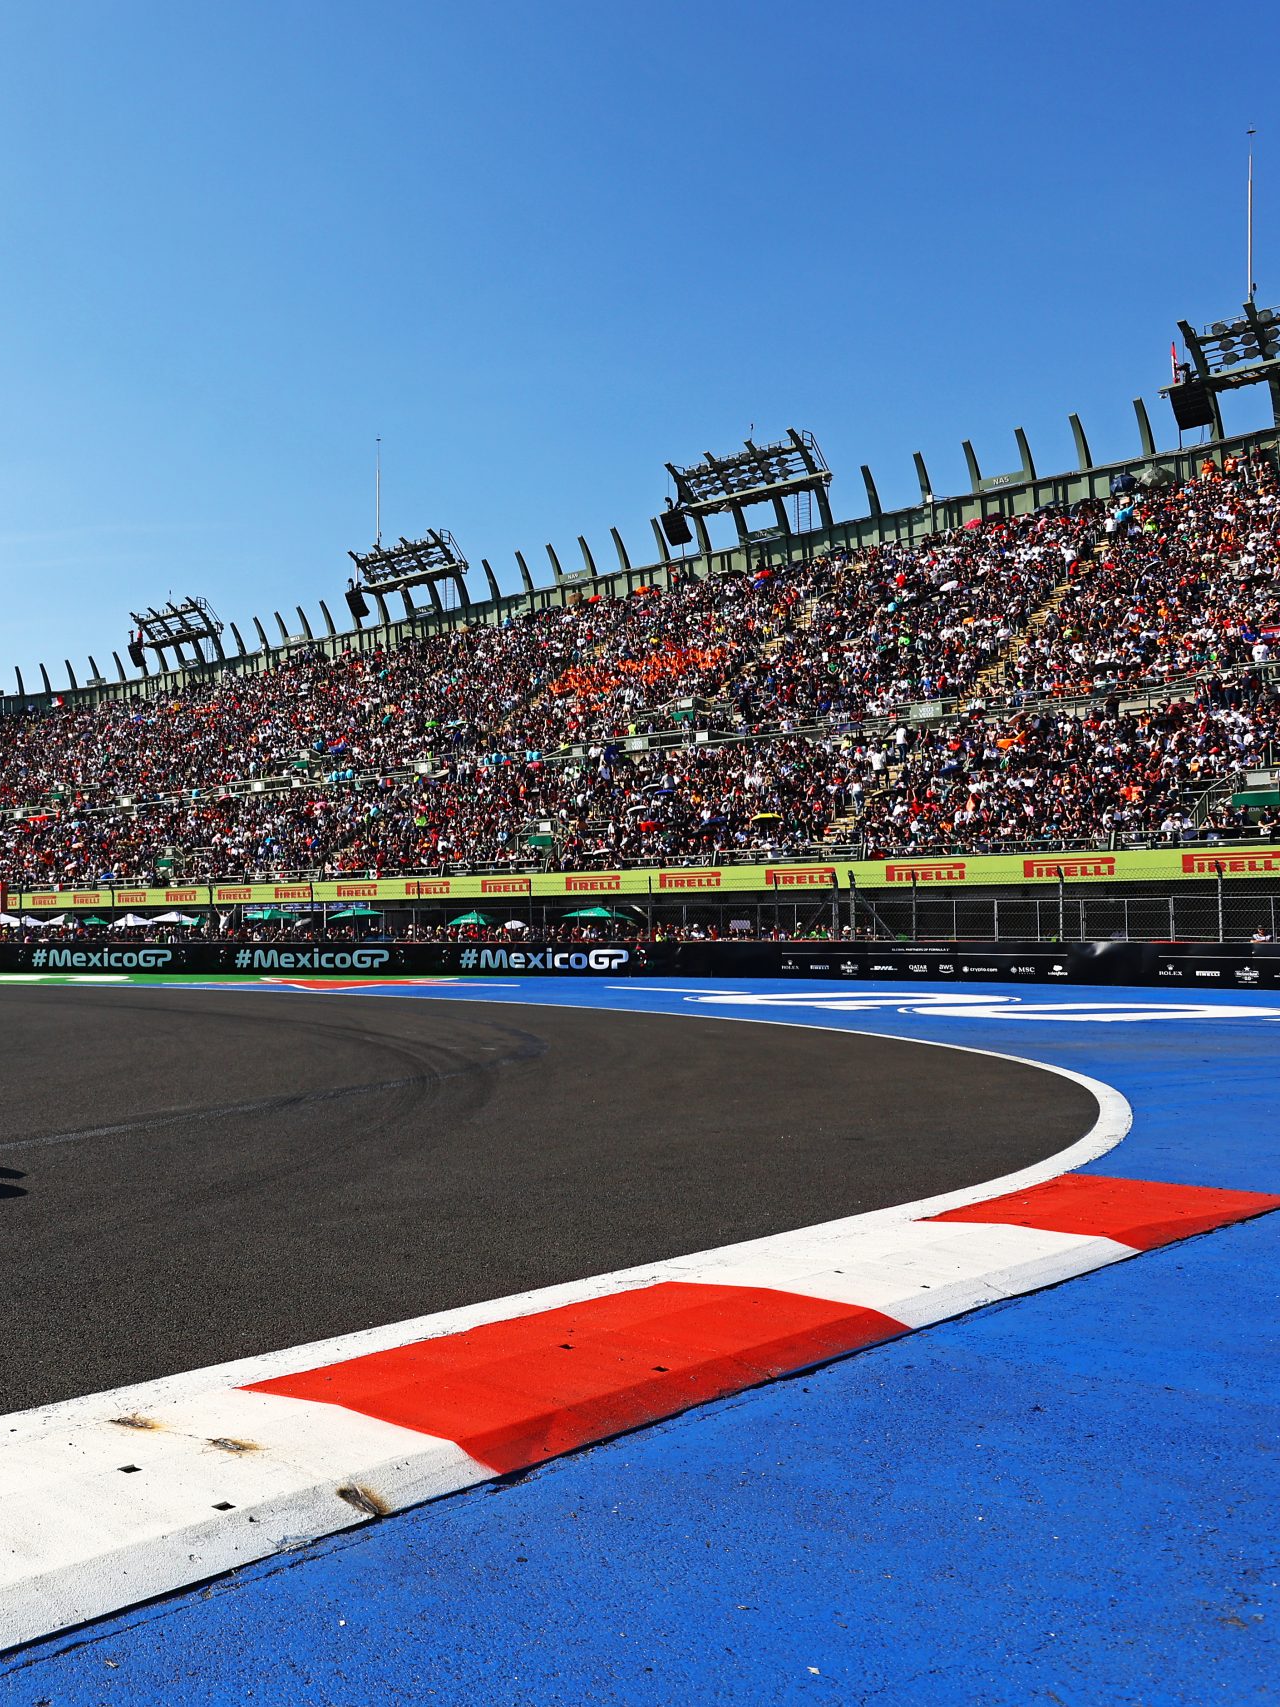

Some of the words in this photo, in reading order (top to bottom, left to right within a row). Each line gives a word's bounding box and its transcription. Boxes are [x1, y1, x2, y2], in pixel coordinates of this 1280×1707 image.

[1023, 857, 1116, 878] PIRELLI
[1182, 850, 1280, 873] PIRELL
[885, 862, 966, 882] PIRELLI
[481, 878, 531, 893] PIRELLI
[566, 875, 621, 891] PIRELLI
[659, 871, 721, 889] PIRELLI
[217, 888, 251, 900] PIRELLI
[275, 886, 313, 898] PIRELLI
[337, 884, 378, 897] PIRELLI
[405, 881, 451, 895] PIRELLI
[32, 895, 56, 905] PIRELLI
[73, 894, 100, 904] PIRELLI
[118, 892, 146, 903] PIRELLI
[166, 890, 197, 902] PIRELLI
[31, 948, 172, 967] #MexicoGP
[234, 948, 390, 968] #MexicoGP
[459, 948, 630, 970] #MexicoGP
